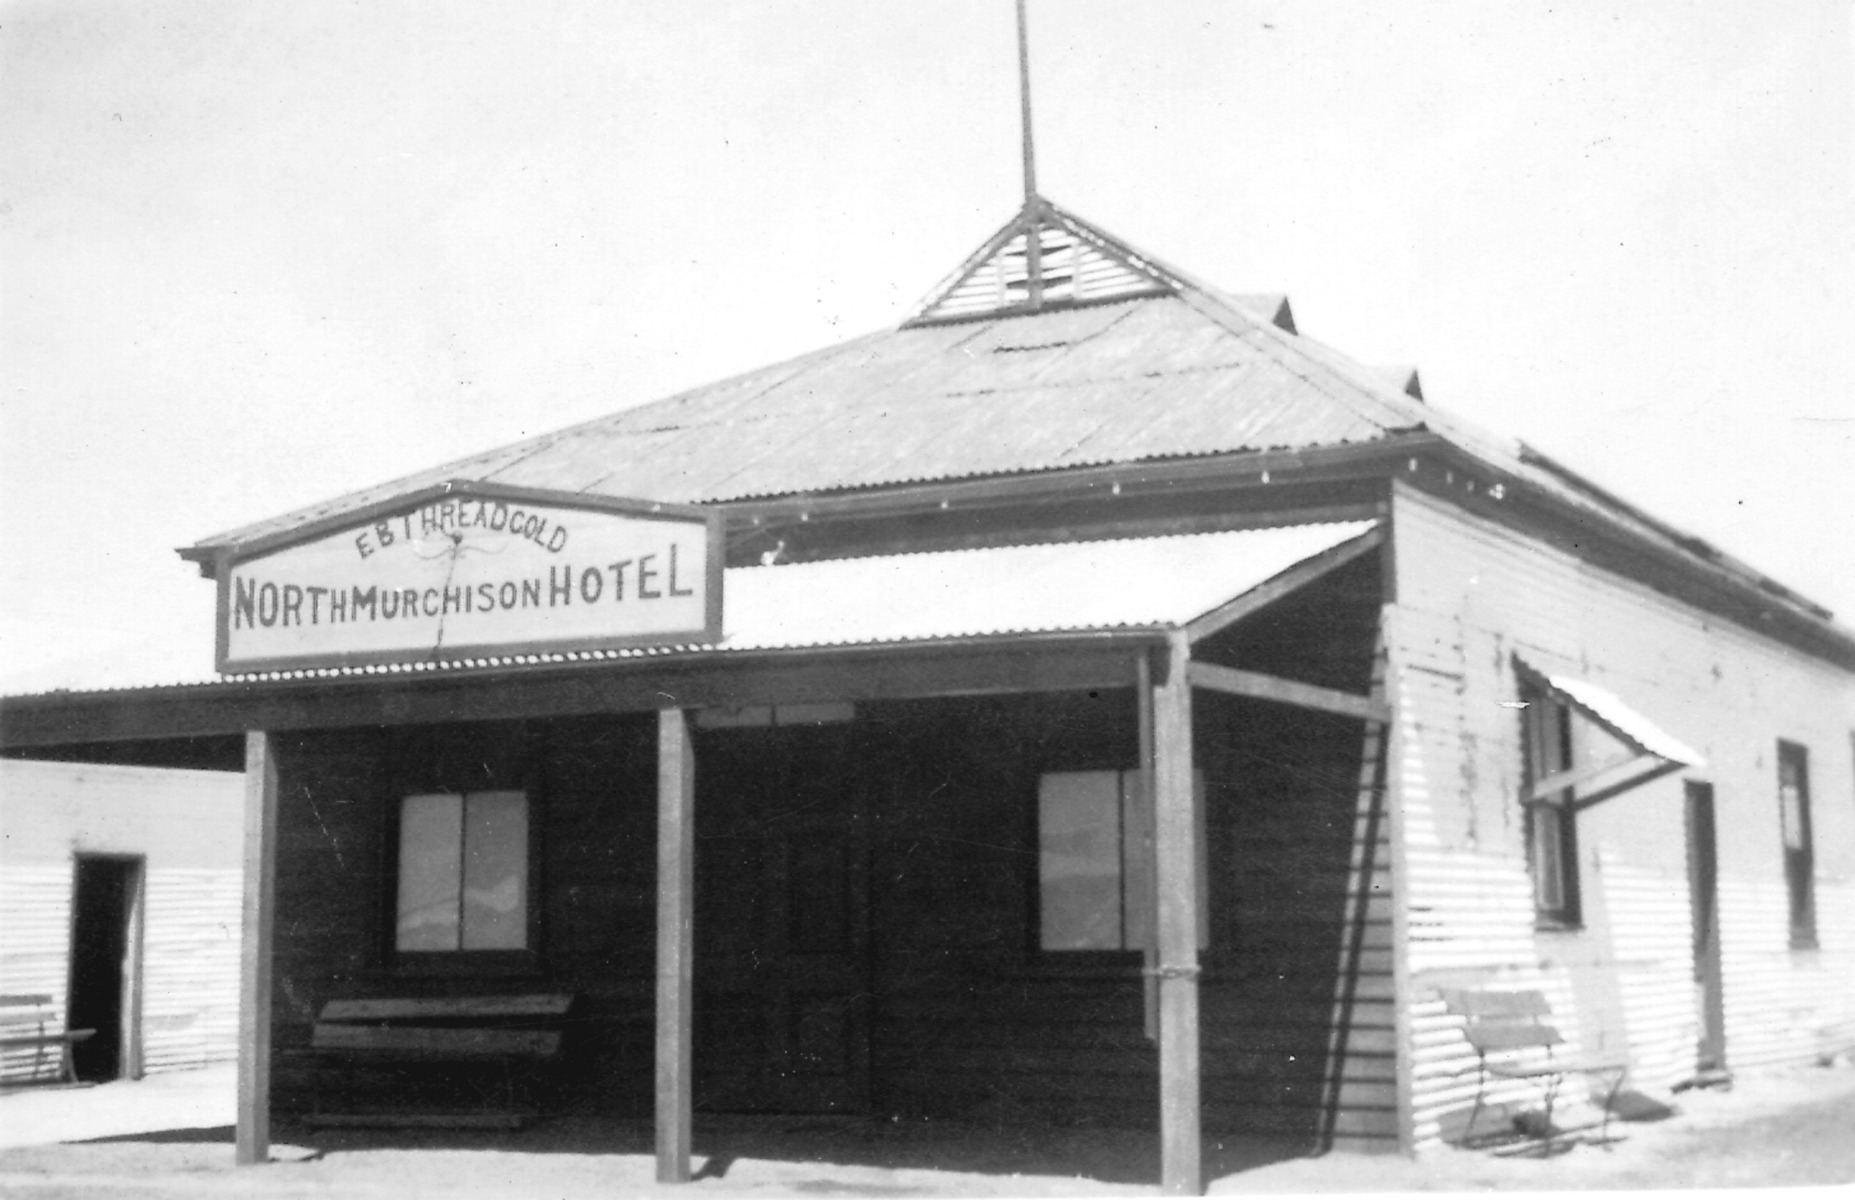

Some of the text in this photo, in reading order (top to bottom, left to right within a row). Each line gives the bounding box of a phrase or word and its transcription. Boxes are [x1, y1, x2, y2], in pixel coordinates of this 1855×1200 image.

[355, 532, 375, 560] E
[234, 543, 694, 630] NORTH MURCHISON HOTEL
